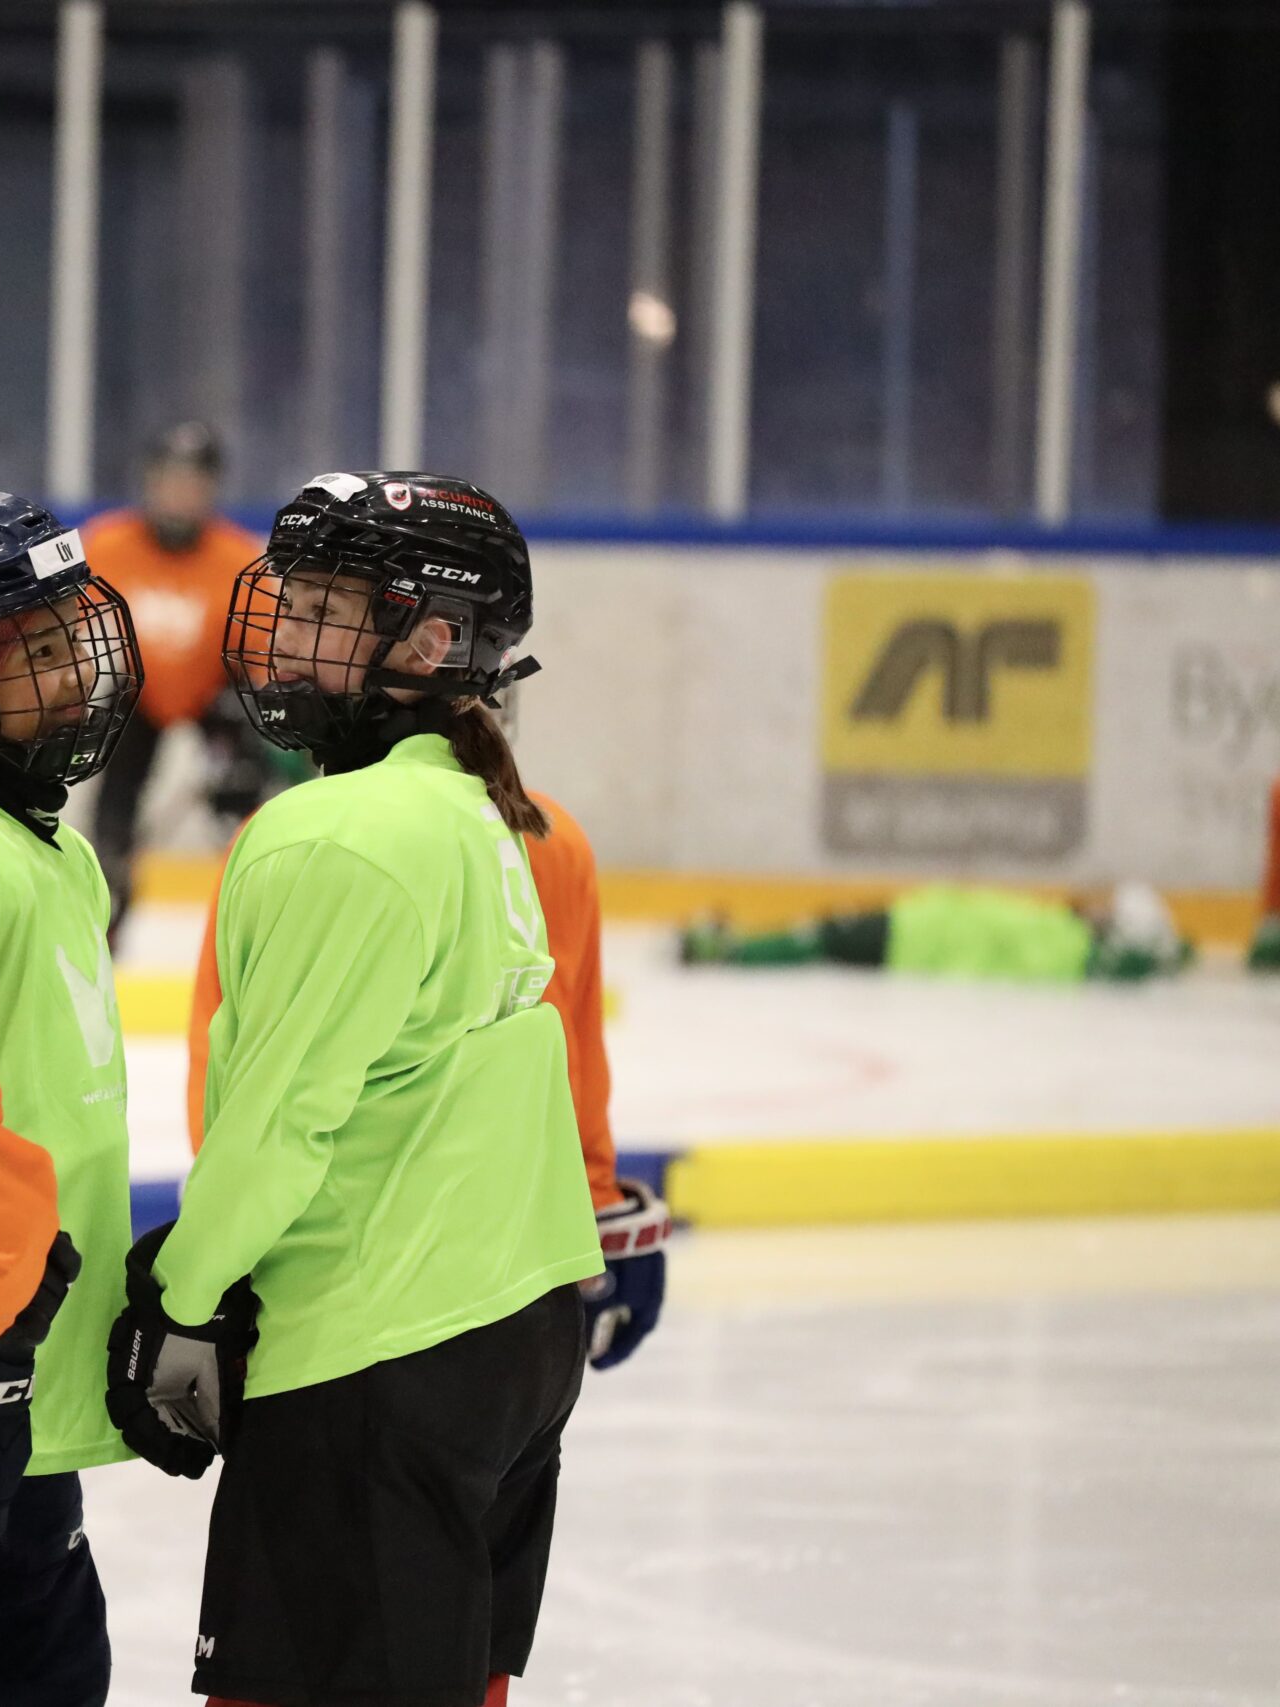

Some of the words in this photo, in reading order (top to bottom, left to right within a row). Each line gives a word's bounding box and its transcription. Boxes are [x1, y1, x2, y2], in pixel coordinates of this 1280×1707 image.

[417, 488, 494, 513] SECURITY
[420, 499, 497, 524] ASSISTANCE
[280, 512, 314, 528] CCM
[420, 562, 482, 585] CCM
